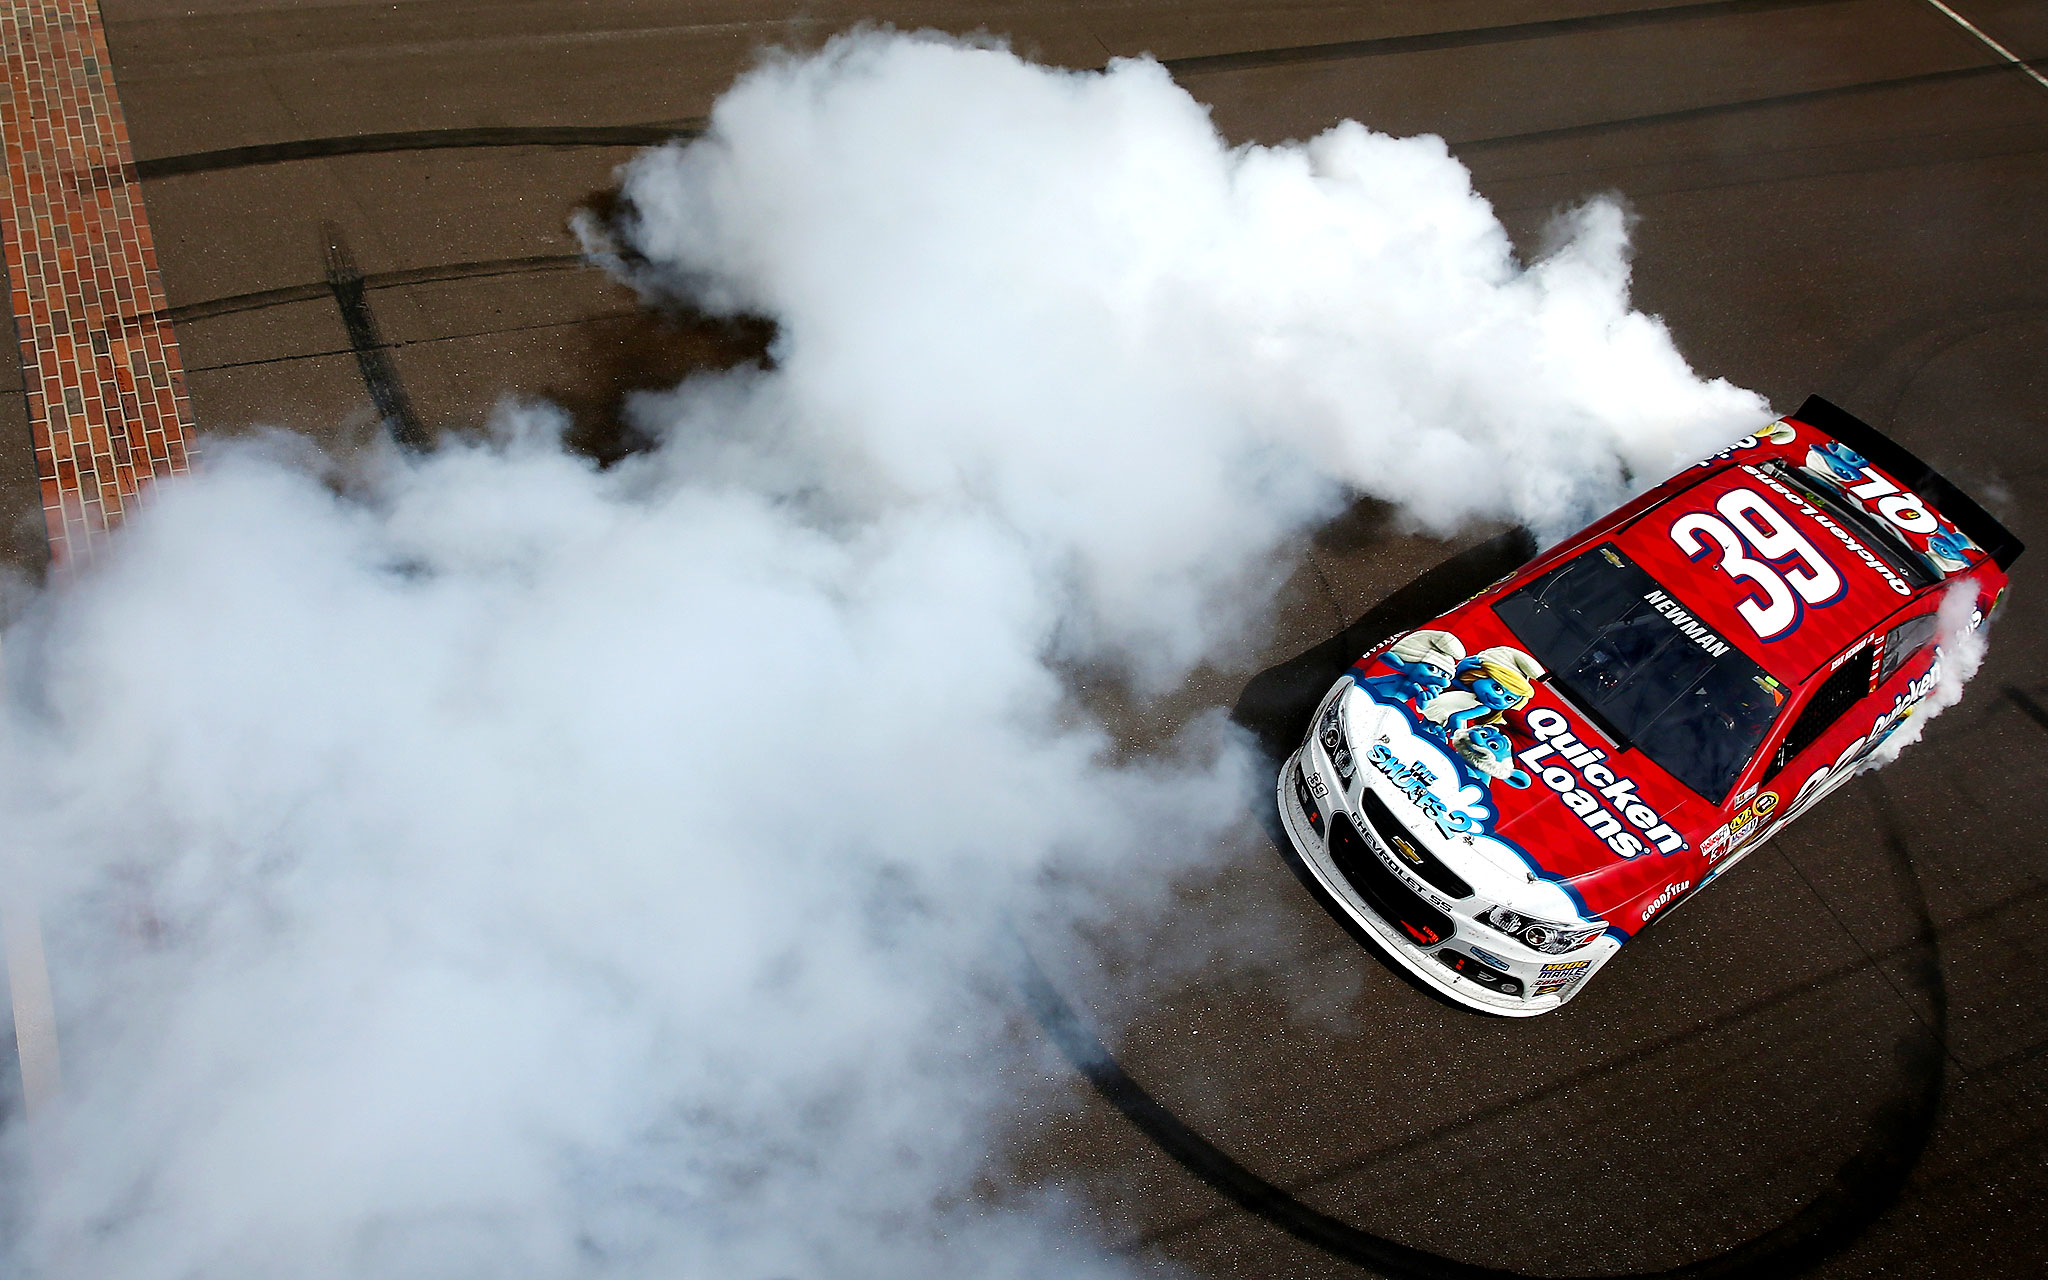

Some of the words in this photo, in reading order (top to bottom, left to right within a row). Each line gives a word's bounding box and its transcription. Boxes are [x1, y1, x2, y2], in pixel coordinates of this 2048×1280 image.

[1669, 487, 1846, 640] 39
[1643, 589, 1731, 658] NEWMAN
[1306, 772, 1330, 799] 39
[1411, 760, 1439, 786] THE
[1516, 742, 1645, 859] Loans
[1525, 706, 1685, 857] Quicken
[1434, 810, 1473, 840] 2
[1351, 811, 1427, 894] CHEVROLET
[1428, 894, 1453, 913] SS
[1641, 879, 1691, 922] GOODYEAR
[1543, 961, 1588, 971] MOOG
